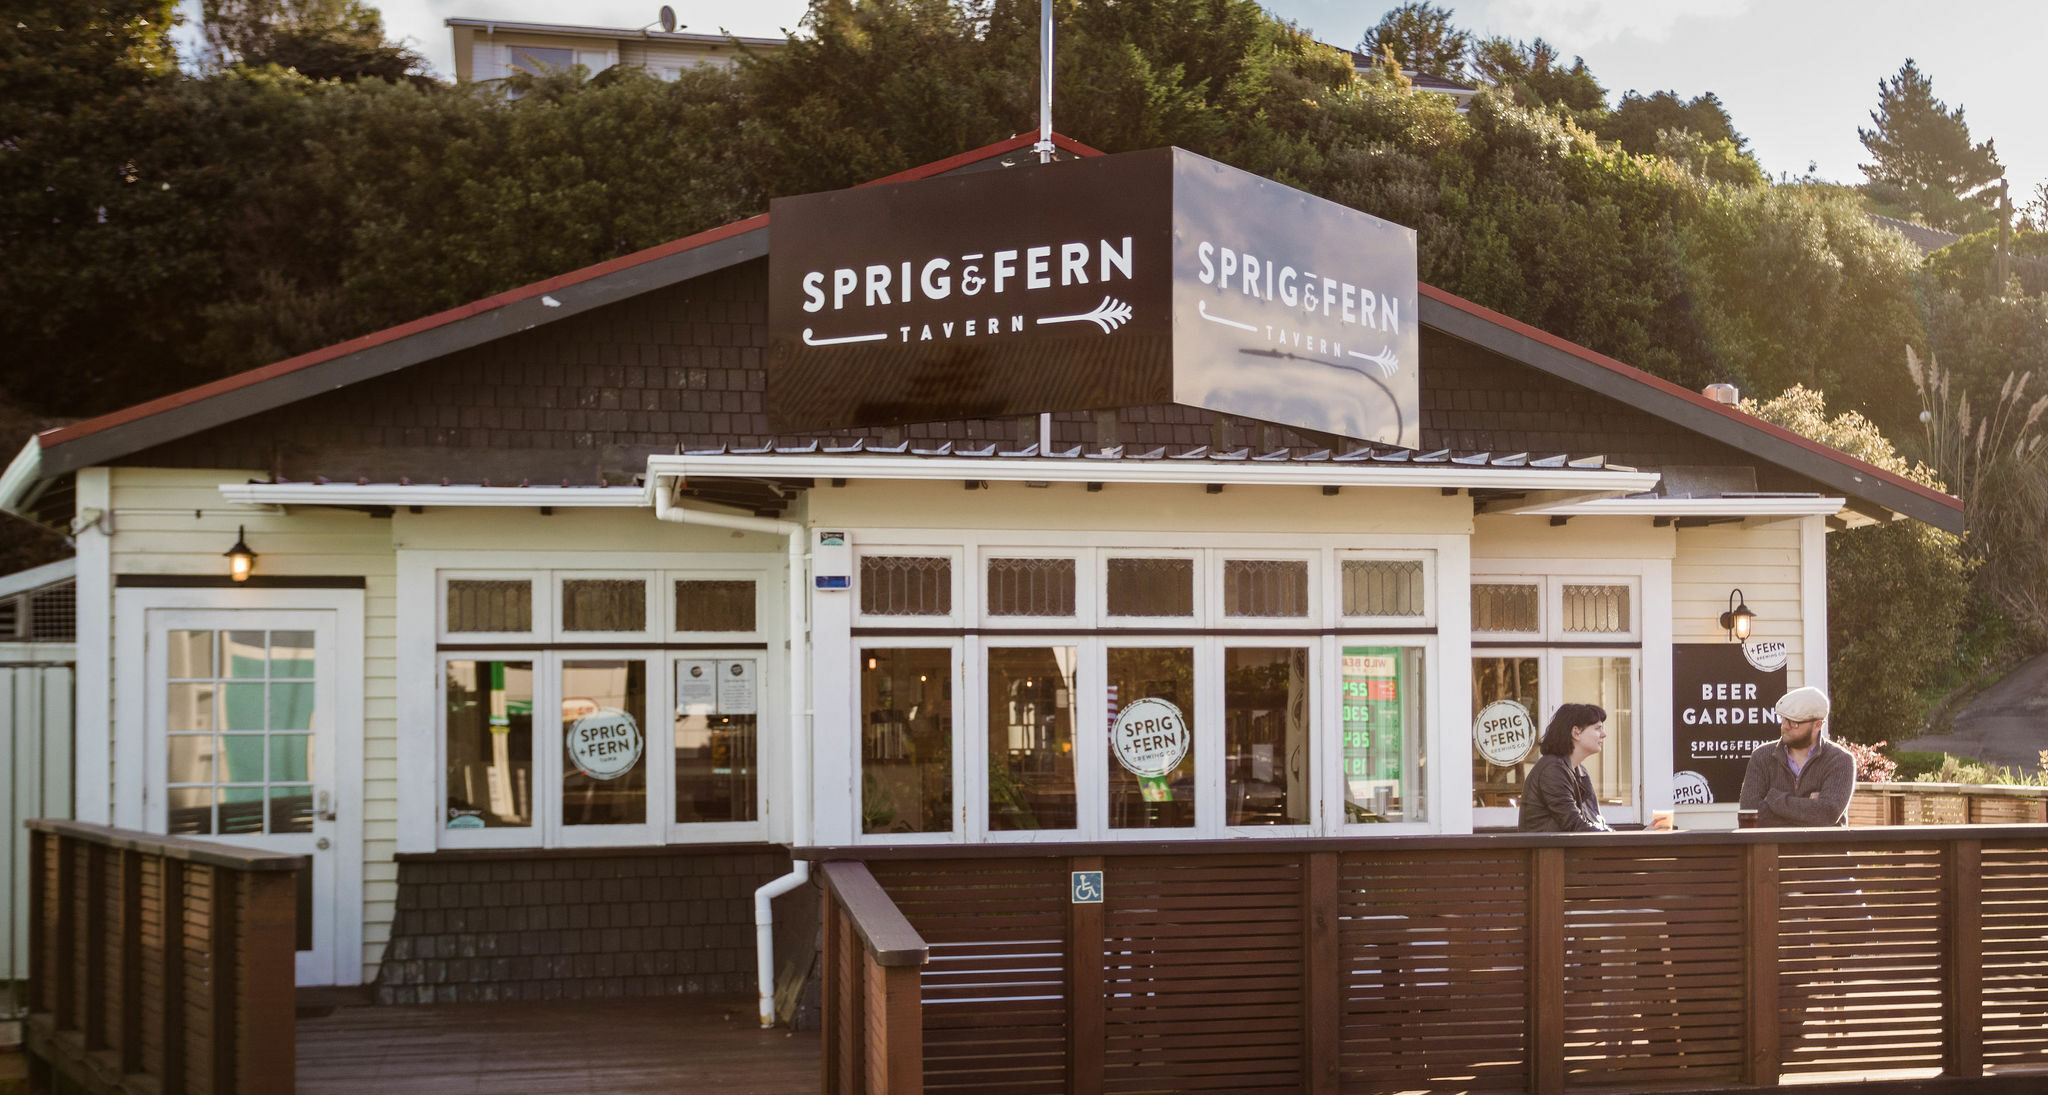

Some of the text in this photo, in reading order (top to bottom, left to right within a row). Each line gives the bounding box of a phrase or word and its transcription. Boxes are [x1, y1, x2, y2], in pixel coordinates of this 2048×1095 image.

[802, 257, 951, 313] SPRIG
[994, 236, 1133, 293] FERN
[1198, 241, 1298, 307] SPRIG
[1323, 277, 1399, 335] FERN
[900, 315, 1024, 343] TAVERN
[1265, 325, 1341, 358] TAVERN
[1702, 683, 1757, 701] BEER
[1483, 715, 1523, 733] SPRIG
[1682, 707, 1775, 725] GARDEN
[581, 724, 627, 742] SPRIG
[1124, 716, 1173, 737] SPRIG
[1691, 740, 1728, 752] SPRIG
